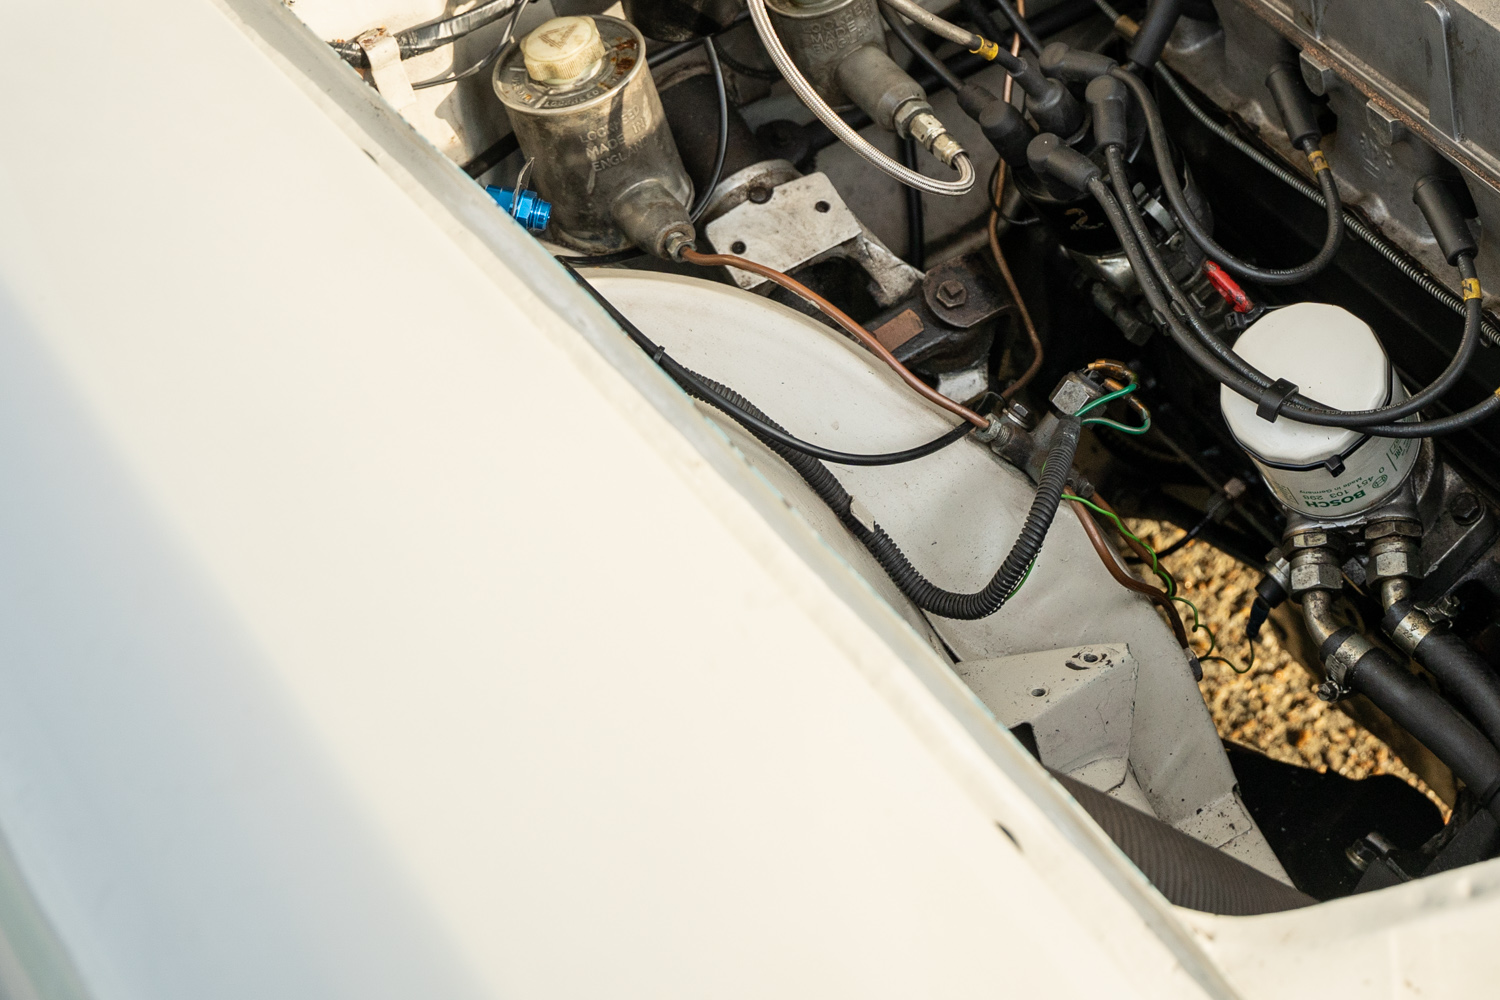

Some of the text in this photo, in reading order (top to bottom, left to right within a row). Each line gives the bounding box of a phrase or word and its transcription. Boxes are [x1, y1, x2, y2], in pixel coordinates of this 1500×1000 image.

[586, 133, 625, 159] MADE
[1356, 475, 1374, 489] 451
[1304, 489, 1366, 508] BOSCH
[1329, 489, 1349, 499] 103
